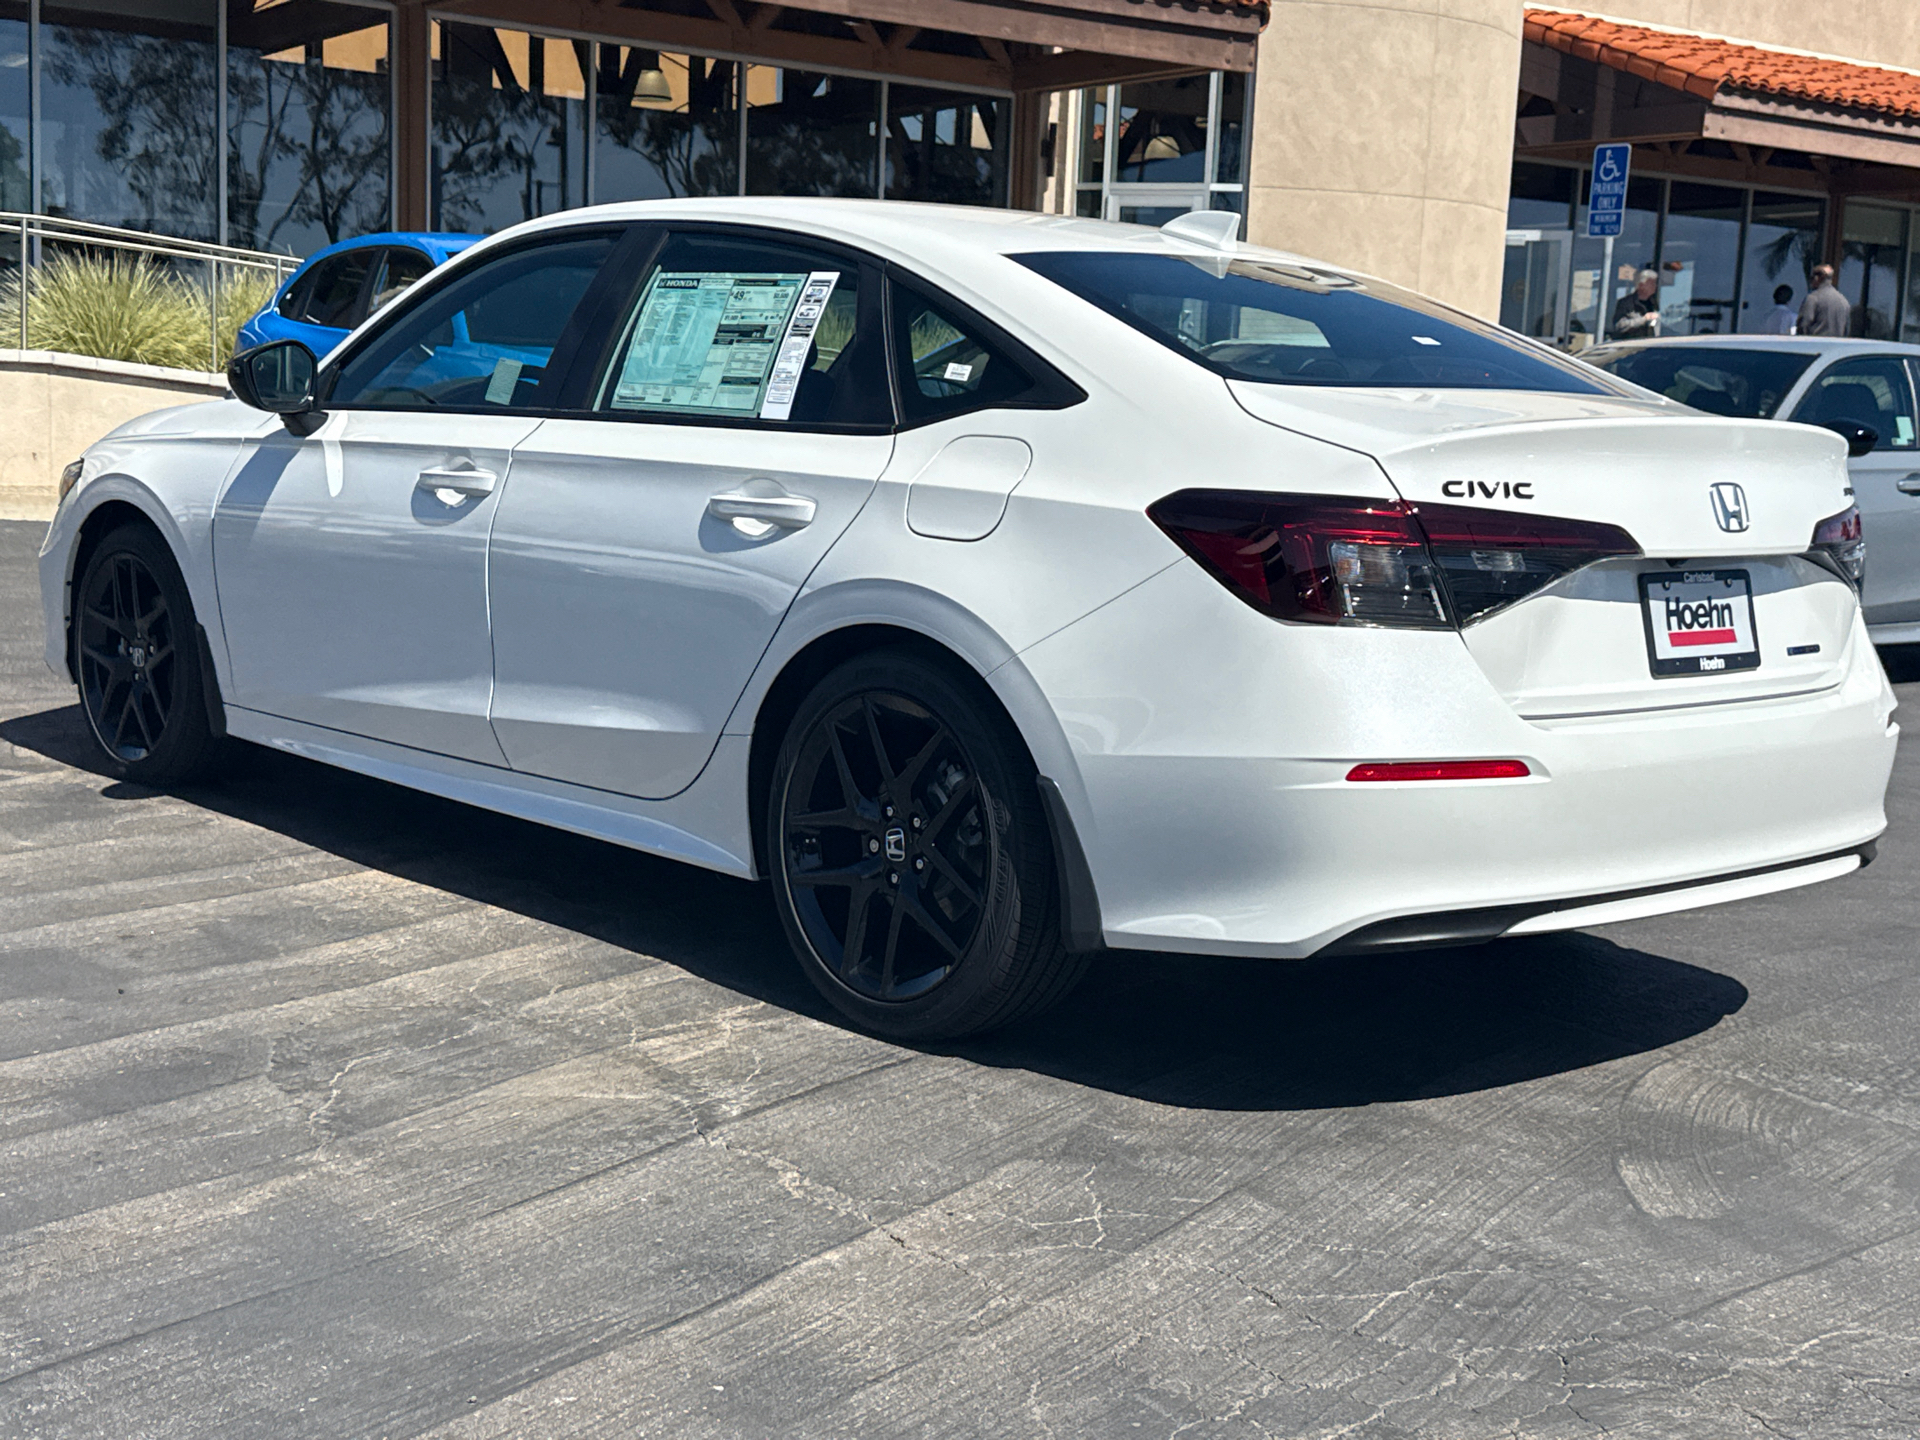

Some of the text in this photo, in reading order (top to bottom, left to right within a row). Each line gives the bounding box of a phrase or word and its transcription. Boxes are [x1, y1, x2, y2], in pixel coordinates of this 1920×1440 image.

[666, 279, 698, 287] HONDA
[1441, 480, 1534, 499] CIVIC
[1683, 572, 1715, 583] Carlsbad
[1665, 596, 1734, 631] Hoehn
[1700, 657, 1726, 670] Hoehn
